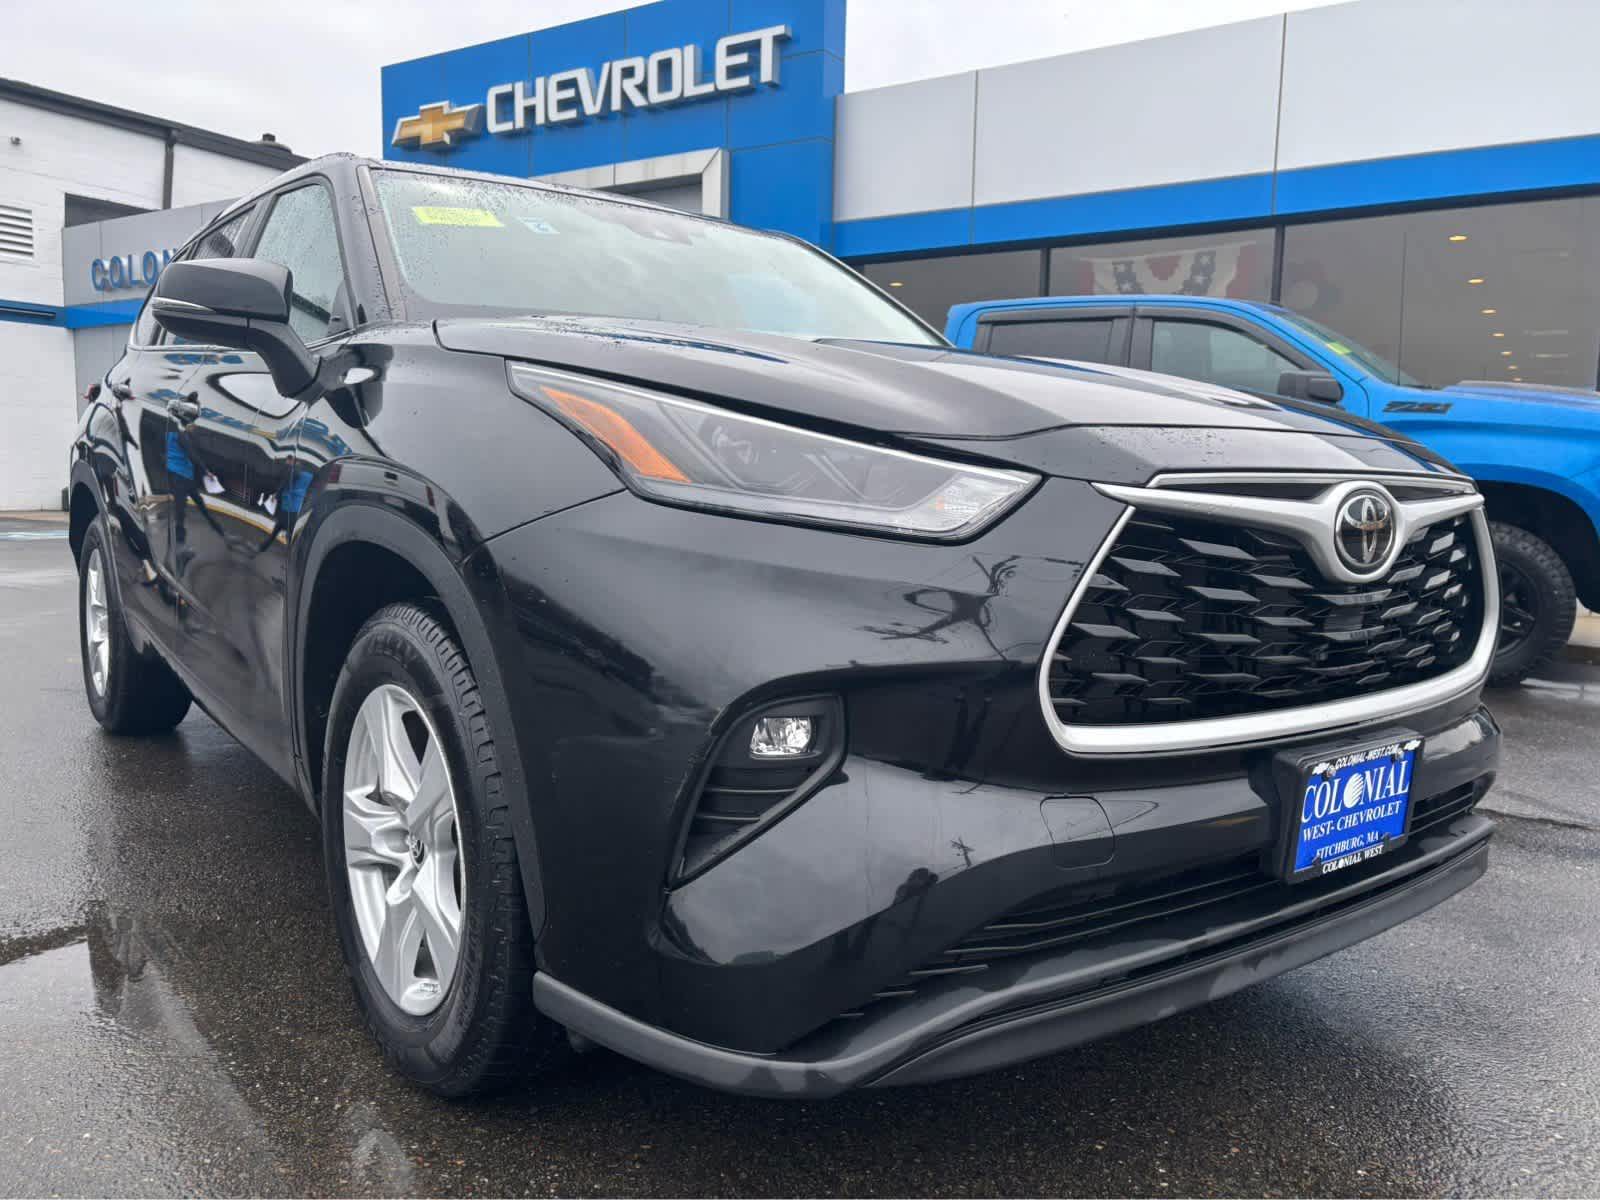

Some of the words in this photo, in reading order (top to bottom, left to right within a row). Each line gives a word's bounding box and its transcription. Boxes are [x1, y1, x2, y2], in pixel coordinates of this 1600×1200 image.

[486, 24, 792, 134] CHEVROLET
[1301, 761, 1410, 823] COLONIAL
[1364, 844, 1384, 859] WEST
[1366, 831, 1380, 845] MA
